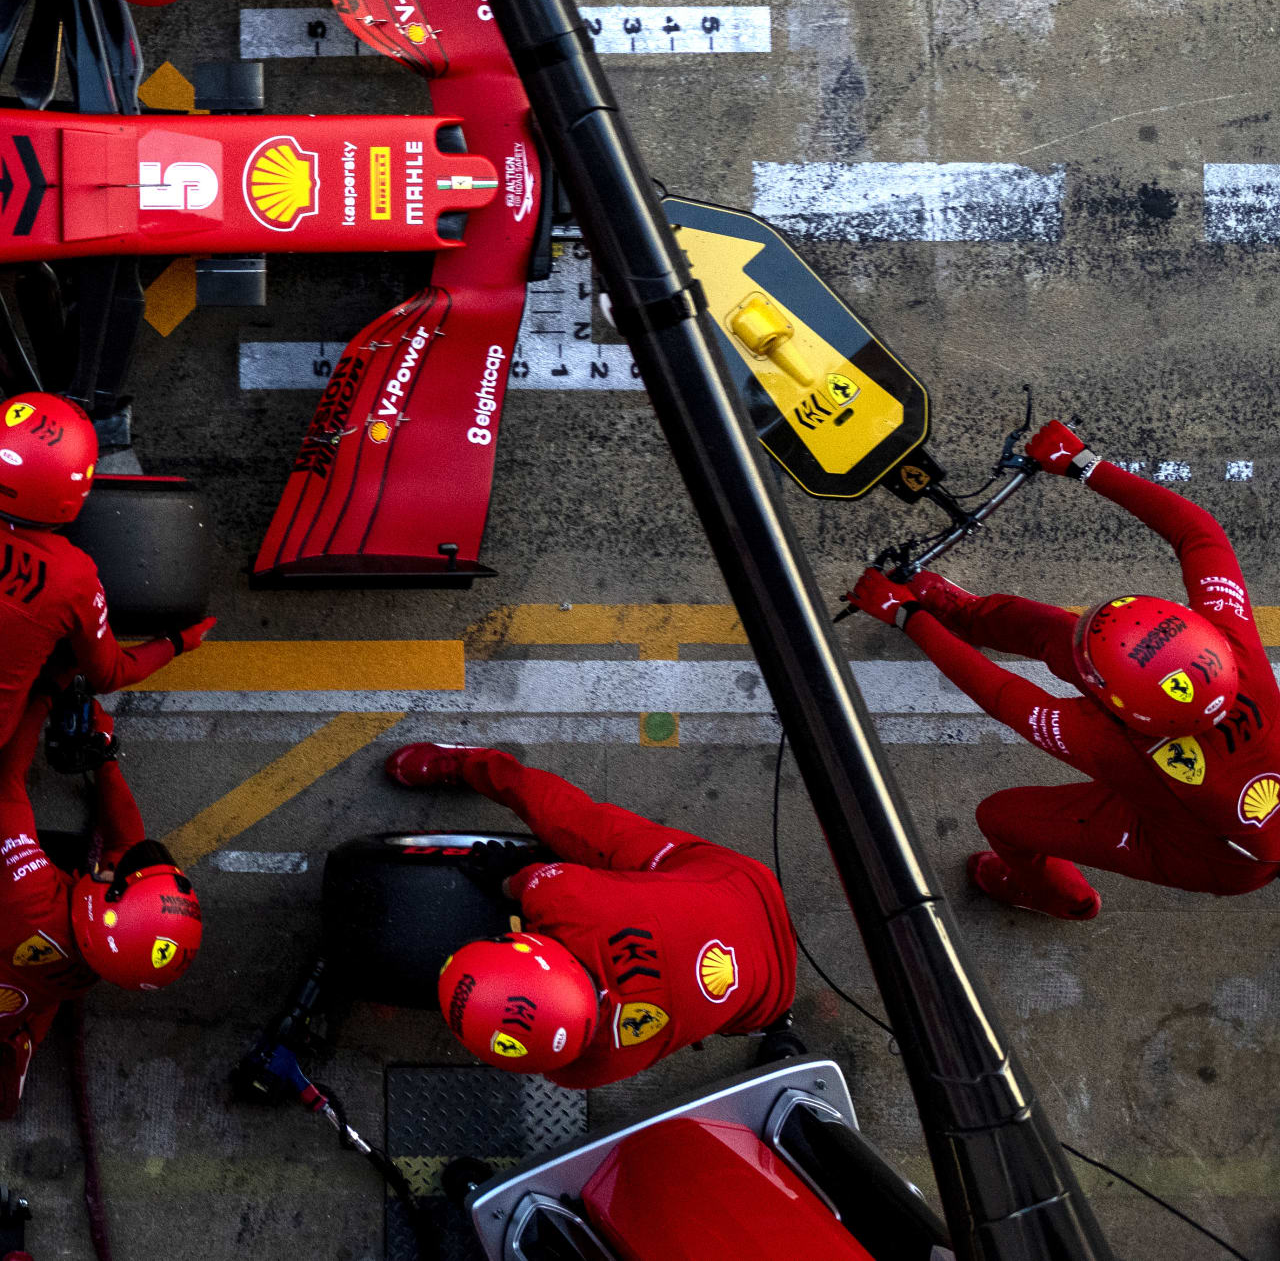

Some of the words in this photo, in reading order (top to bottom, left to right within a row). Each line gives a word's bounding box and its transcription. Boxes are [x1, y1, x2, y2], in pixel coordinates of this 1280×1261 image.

[140, 162, 219, 210] 5
[341, 141, 358, 226] kaspersky
[406, 141, 423, 225] MAHLE
[377, 326, 429, 416] V-Power
[474, 345, 506, 426] eightcap
[1051, 710, 1070, 754] HUBLOT
[13, 857, 48, 881] HUBLOT
